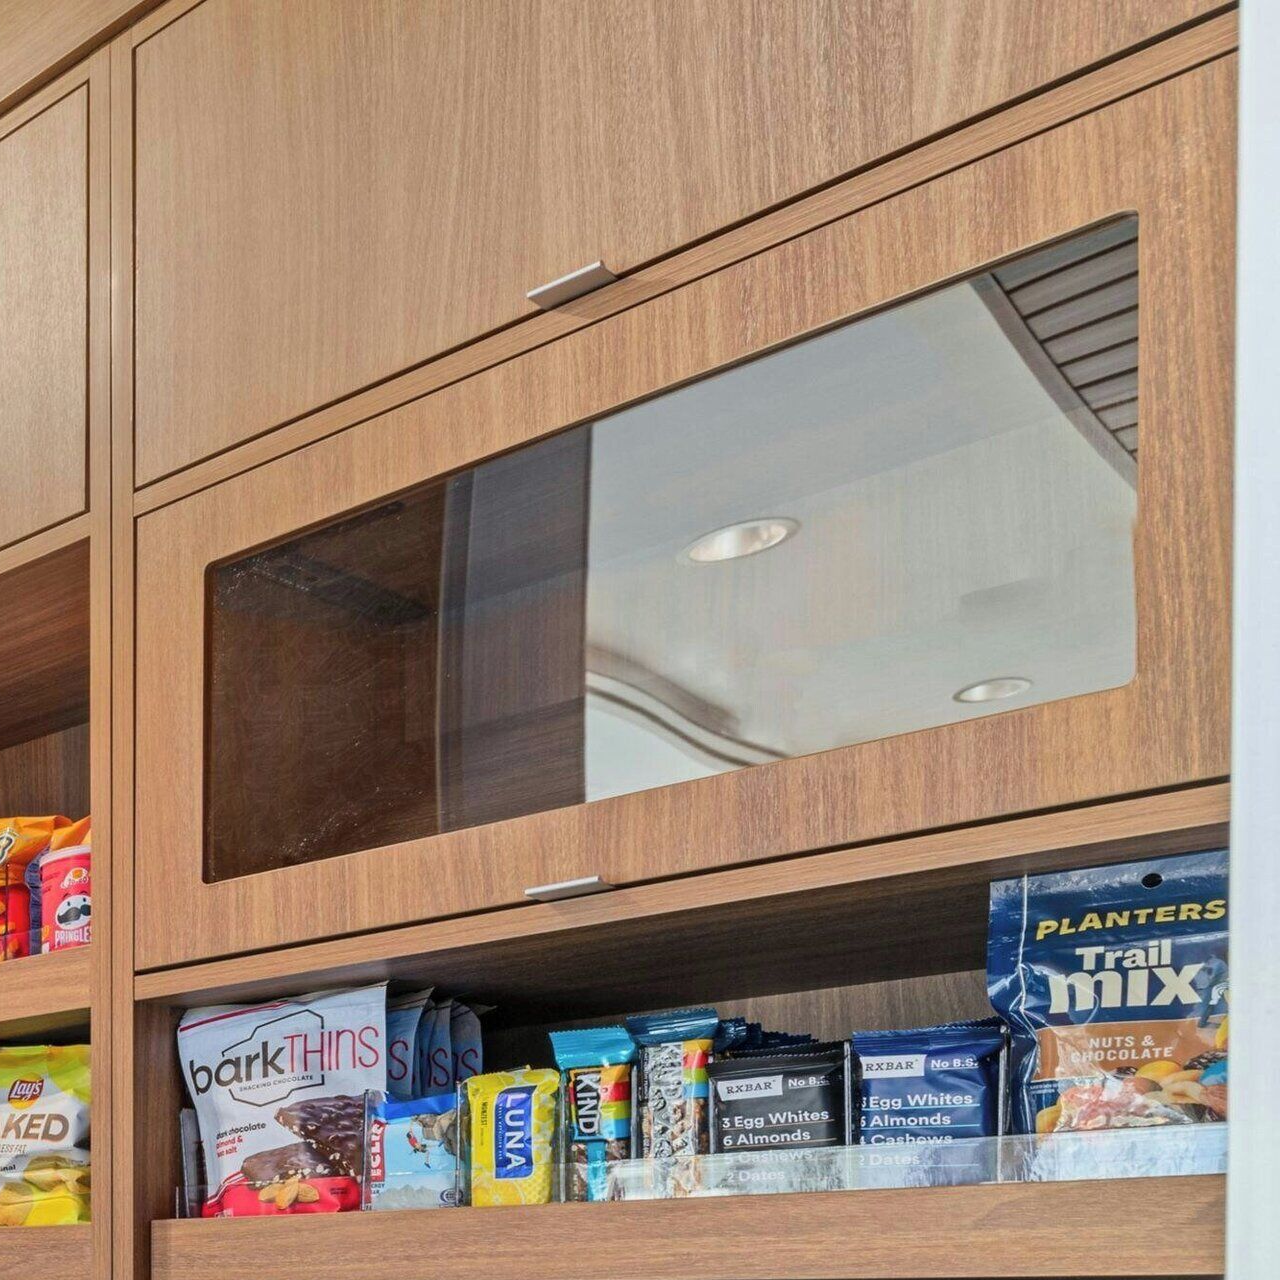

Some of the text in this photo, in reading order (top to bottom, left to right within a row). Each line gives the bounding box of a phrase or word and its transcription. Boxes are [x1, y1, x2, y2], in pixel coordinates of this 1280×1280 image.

[1034, 898, 1227, 941] PLANTERS
[1075, 939, 1172, 972] Trail
[1048, 960, 1205, 1015] mix
[1086, 1035, 1156, 1050] NUTS &
[930, 1058, 948, 1069] No
[1069, 1045, 1175, 1065] CHOCOLATE
[865, 1060, 915, 1073] RXBAR
[10, 1078, 44, 1101] Lay's
[725, 1080, 773, 1095] RXBAR
[575, 1073, 601, 1135] KIND
[868, 1091, 973, 1112] Egg Whites
[236, 1121, 267, 1137] chocolate
[722, 1108, 830, 1131] 3 Egg Whites
[869, 1112, 952, 1127] Almonds
[504, 1092, 526, 1170] LUNA
[722, 1128, 811, 1147] 6 Almonds
[867, 1152, 920, 1166] Dates
